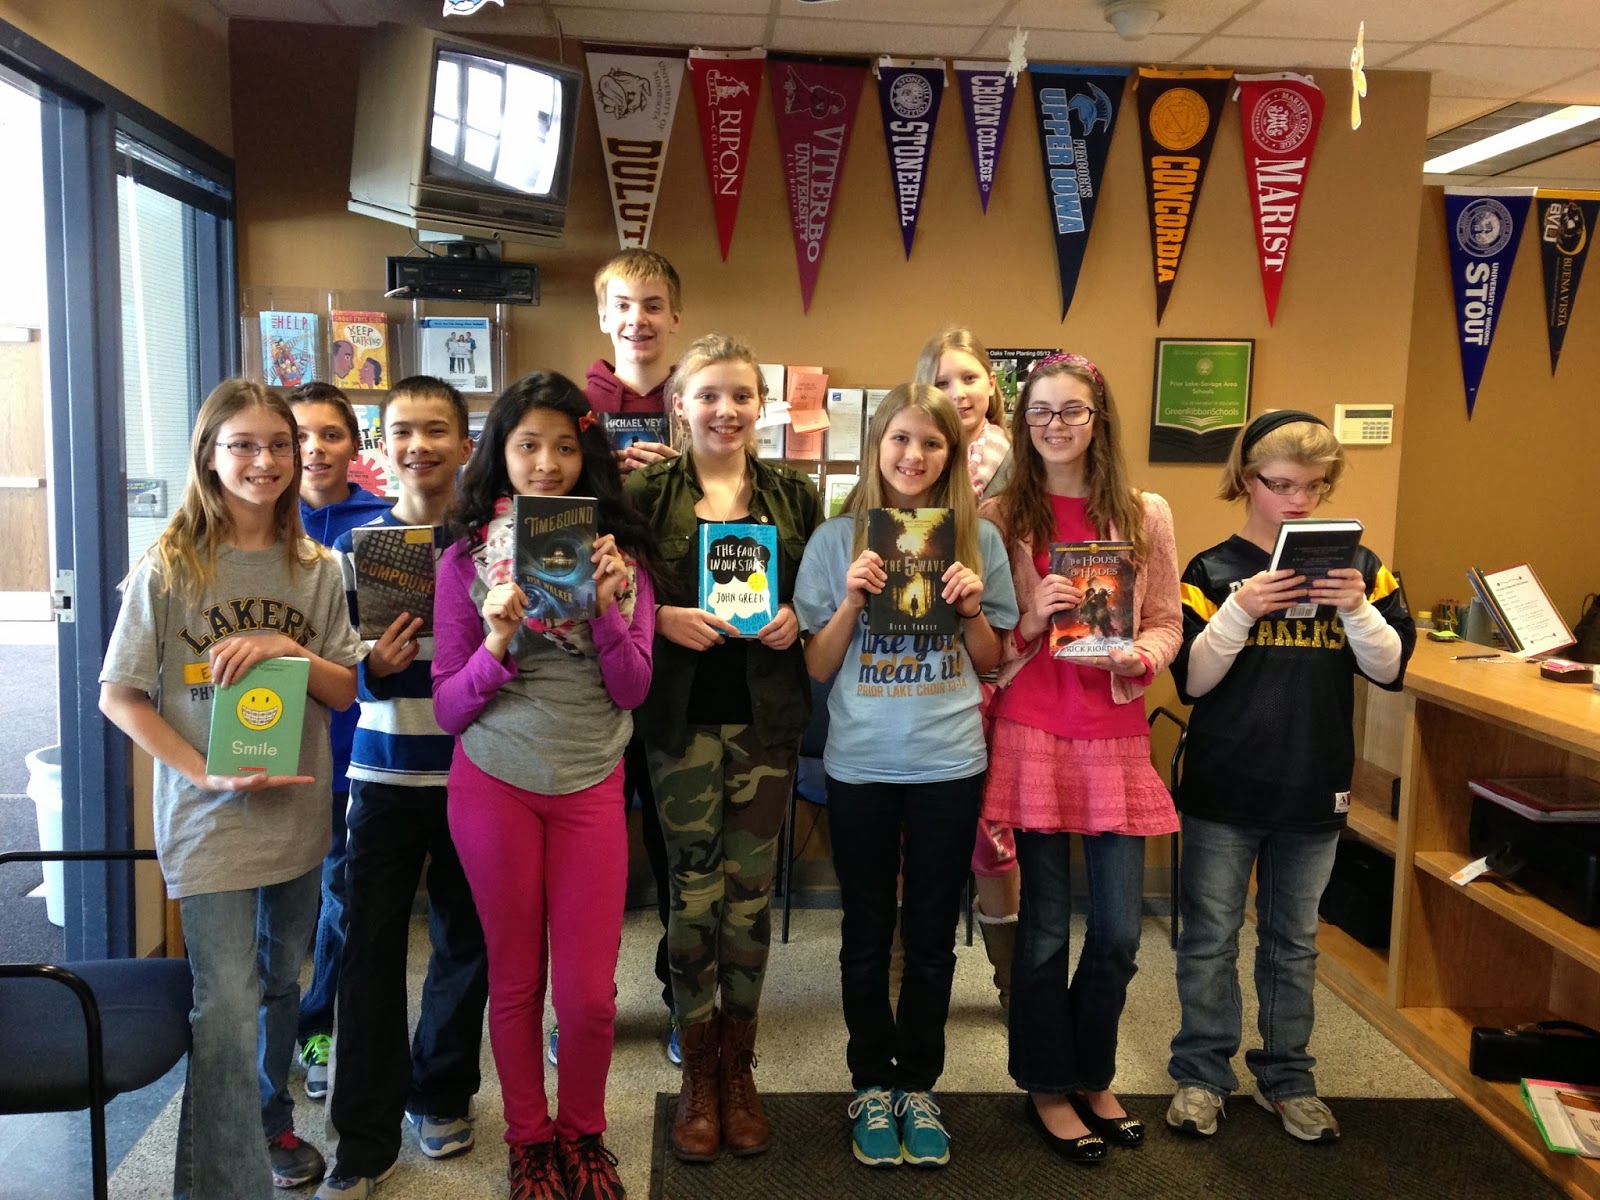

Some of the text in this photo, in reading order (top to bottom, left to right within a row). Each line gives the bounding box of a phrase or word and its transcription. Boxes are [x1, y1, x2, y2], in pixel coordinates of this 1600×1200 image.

[652, 70, 662, 120] MINNESOTA
[657, 60, 671, 118] UNIVERSITY
[1281, 91, 1308, 115] MARIST
[970, 75, 1007, 182] CROWN COLLEGE
[1280, 117, 1309, 150] COLLEGE
[711, 125, 719, 179] COLLEGE
[719, 109, 742, 196] RIPON
[1039, 87, 1086, 235] UPPER IOWA
[1073, 139, 1093, 198] PEACOCKS
[605, 136, 664, 249] DULUT
[794, 142, 810, 243] UNIVERSITY
[807, 123, 847, 263] VITERBO
[889, 120, 930, 227] STONEHILL
[1151, 155, 1201, 285] CONCORDIA
[1254, 156, 1307, 273] MARIST
[1543, 203, 1562, 244] BVU
[1464, 261, 1491, 346] STOUT
[1483, 262, 1500, 346] UNIVERSITY OF WISCONSIN
[1557, 257, 1573, 327] BUENA VISTA
[277, 315, 308, 330] HELP
[347, 325, 374, 337] KEEP
[605, 418, 662, 428] MICHAEL VEY
[524, 505, 594, 537] TIMEBOUND
[710, 558, 720, 571] IN
[721, 559, 736, 572] OUR
[715, 544, 762, 558] THE FAULT
[885, 560, 901, 572] THE
[918, 560, 945, 572] WAVE
[1083, 555, 1120, 567] HOUSE
[1081, 567, 1118, 578] HADES
[716, 592, 736, 604] JOHN
[177, 597, 320, 657] LAKERS
[1244, 613, 1347, 650] AKERS
[1066, 645, 1086, 653] RICK
[857, 684, 884, 698] PRIOR
[887, 684, 913, 698] LAKE
[916, 683, 946, 697] CHOIR
[858, 662, 937, 684] mean
[231, 740, 278, 757] Smile
